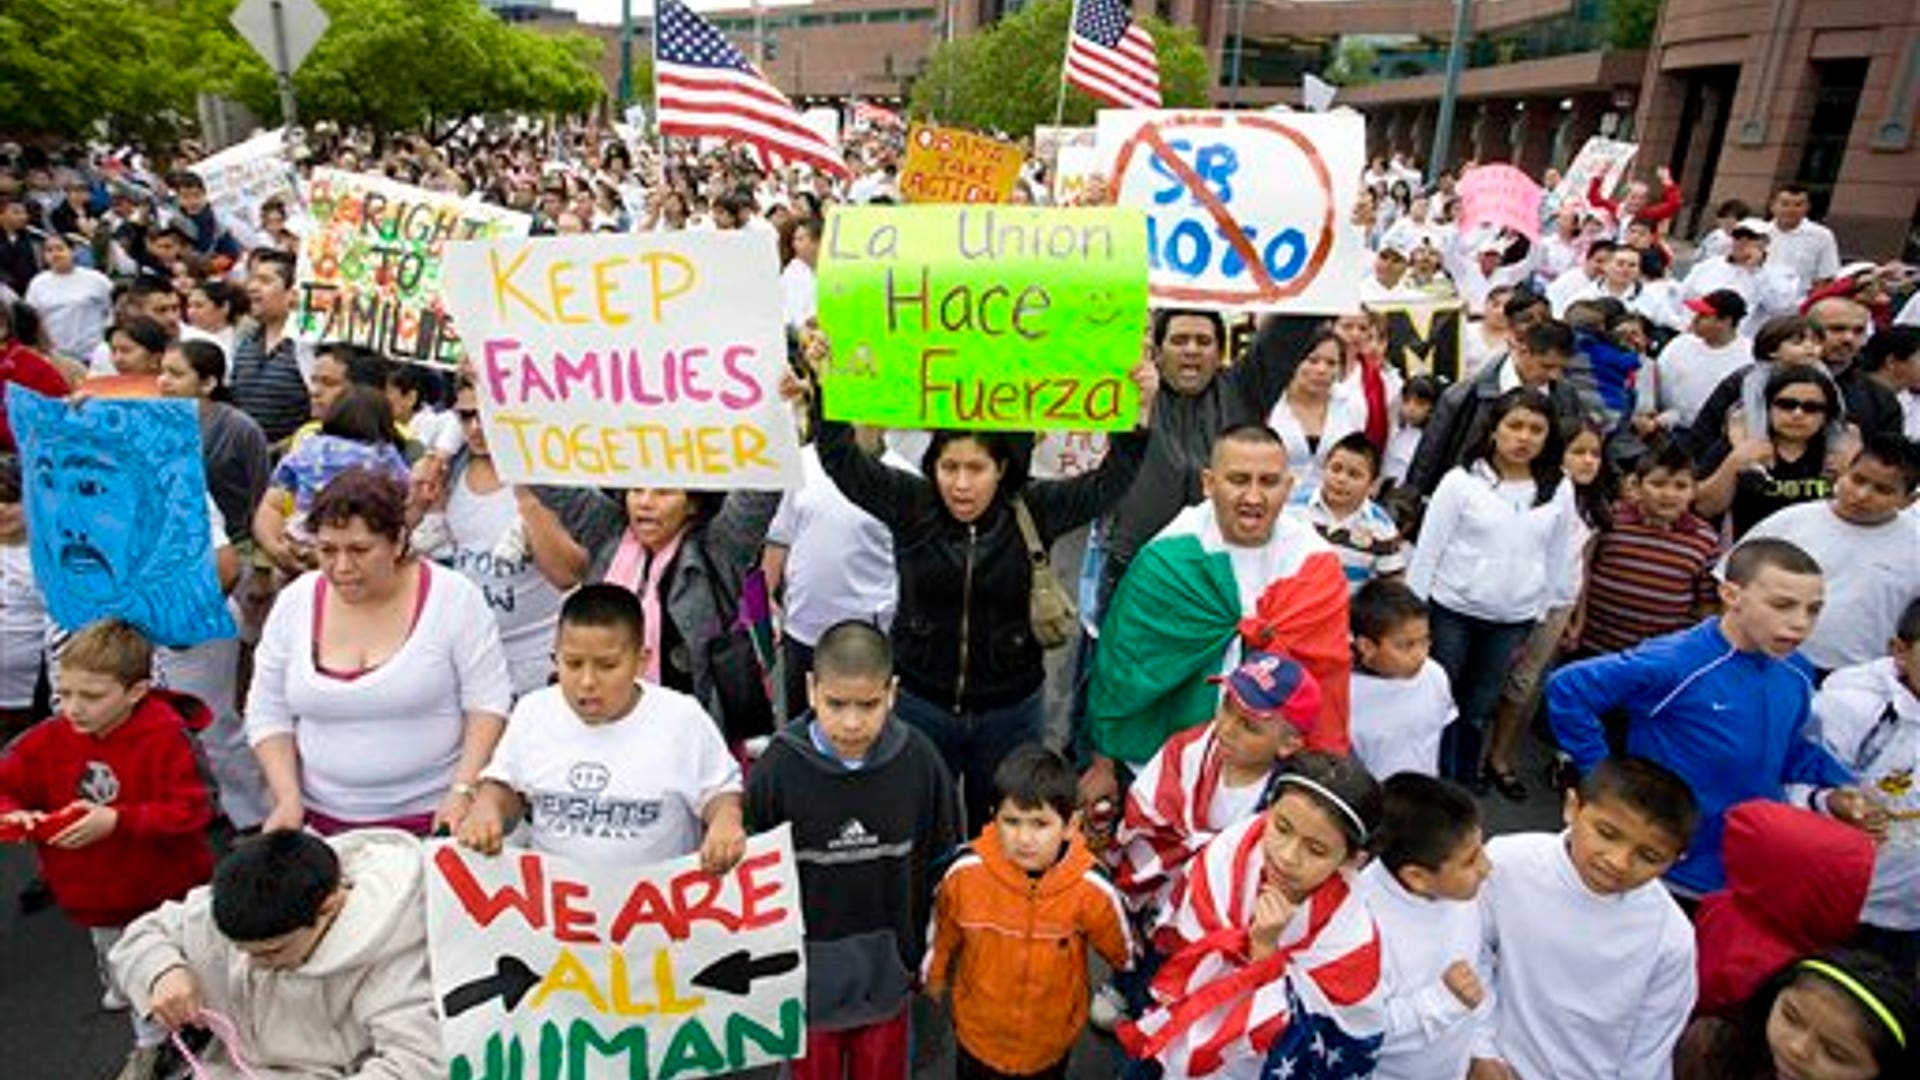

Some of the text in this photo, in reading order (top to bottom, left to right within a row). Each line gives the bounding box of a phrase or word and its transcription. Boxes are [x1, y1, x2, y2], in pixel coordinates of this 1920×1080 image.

[938, 155, 993, 182] TAKE
[1148, 138, 1240, 206] SB
[371, 246, 425, 292] TO
[828, 209, 1113, 262] La Union
[300, 282, 461, 364] FAMILIE
[487, 246, 698, 329] KEEP
[885, 267, 1053, 339] Hace
[482, 338, 764, 411] FAMILIES
[919, 346, 1123, 424] Fuerza
[493, 412, 780, 476] TOGETHER
[434, 845, 790, 946] WE ARE
[530, 947, 707, 1018] ALL
